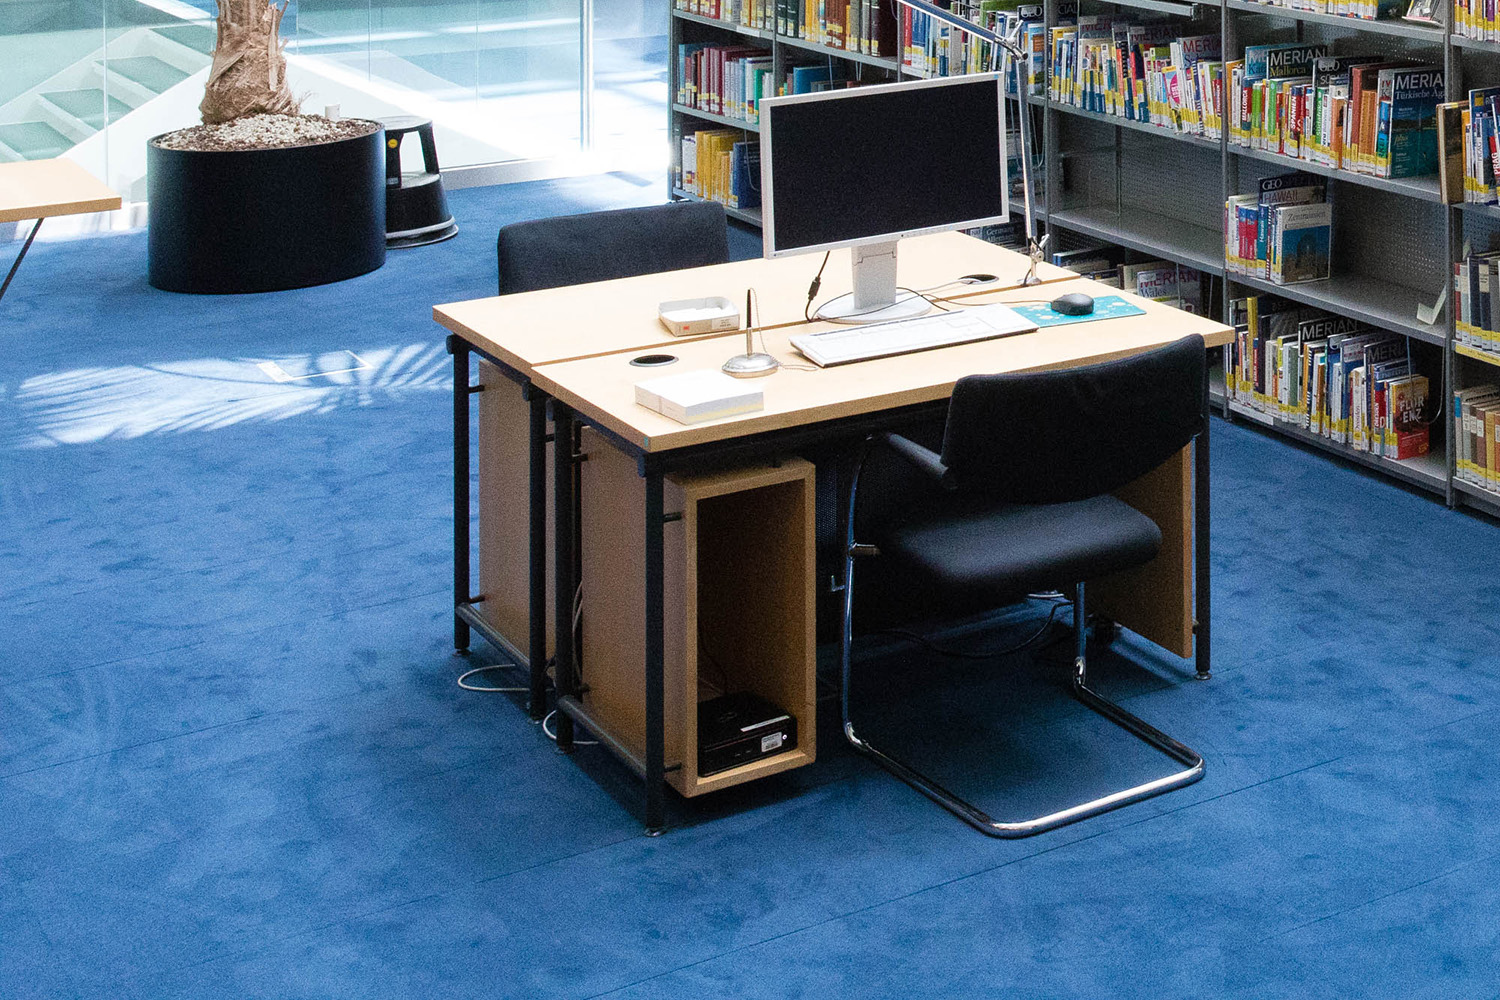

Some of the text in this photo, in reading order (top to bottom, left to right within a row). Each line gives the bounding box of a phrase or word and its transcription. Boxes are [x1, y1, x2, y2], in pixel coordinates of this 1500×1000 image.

[1270, 49, 1327, 67] MERIAN
[1270, 66, 1307, 77] Mallorca
[1396, 73, 1445, 90] MERIA
[1396, 88, 1430, 100] Türkische
[1491, 152, 1500, 175] PRAG
[1262, 179, 1282, 191] GEO
[1140, 288, 1167, 298] Wales
[1302, 320, 1358, 341] MERIAN
